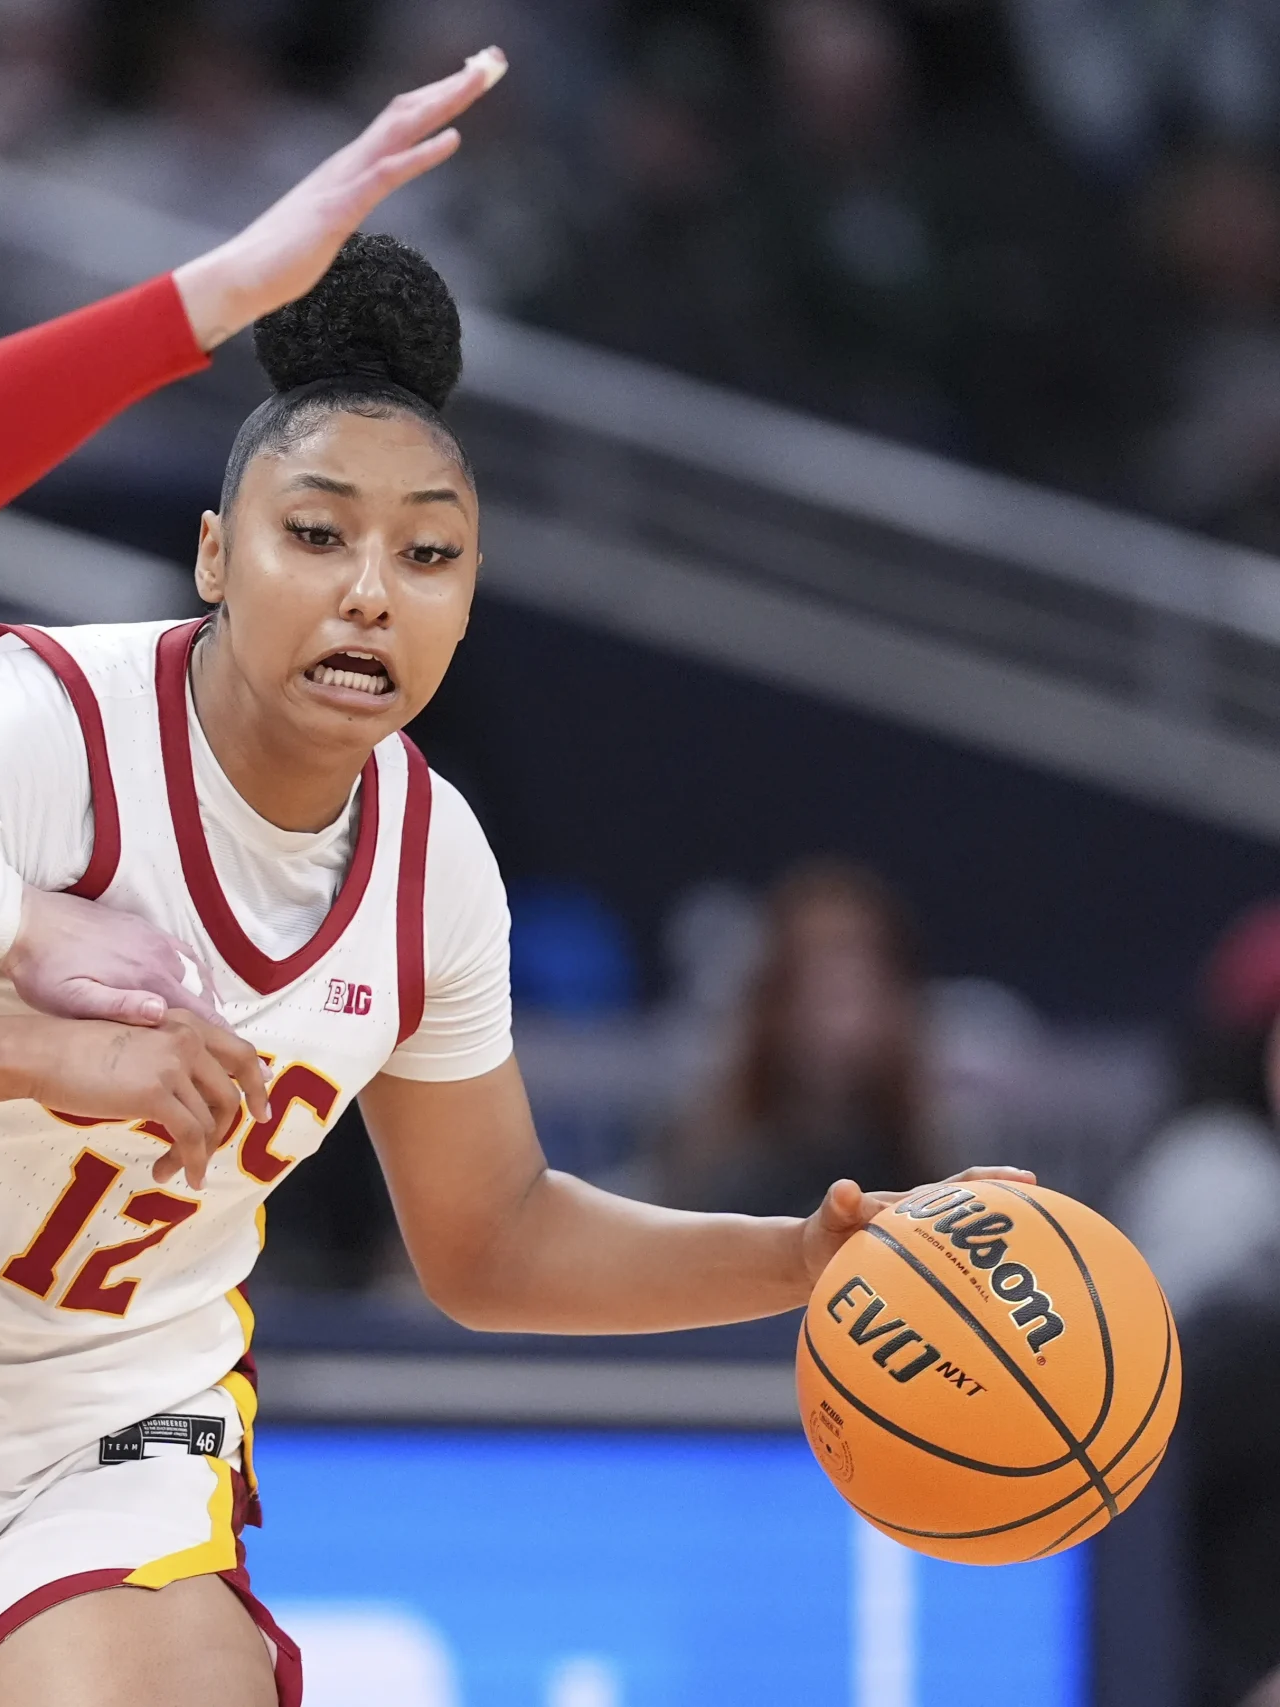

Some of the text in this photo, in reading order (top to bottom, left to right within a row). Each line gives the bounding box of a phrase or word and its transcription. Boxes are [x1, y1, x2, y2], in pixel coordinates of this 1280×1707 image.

[893, 1184, 1066, 1356] Wilson
[913, 1227, 990, 1304] INDOOR GAME BALL
[826, 1274, 988, 1398] EVO NXT
[107, 1443, 139, 1451] TEAM
[141, 1419, 188, 1428] ENGINEERED
[196, 1431, 216, 1453] 46
